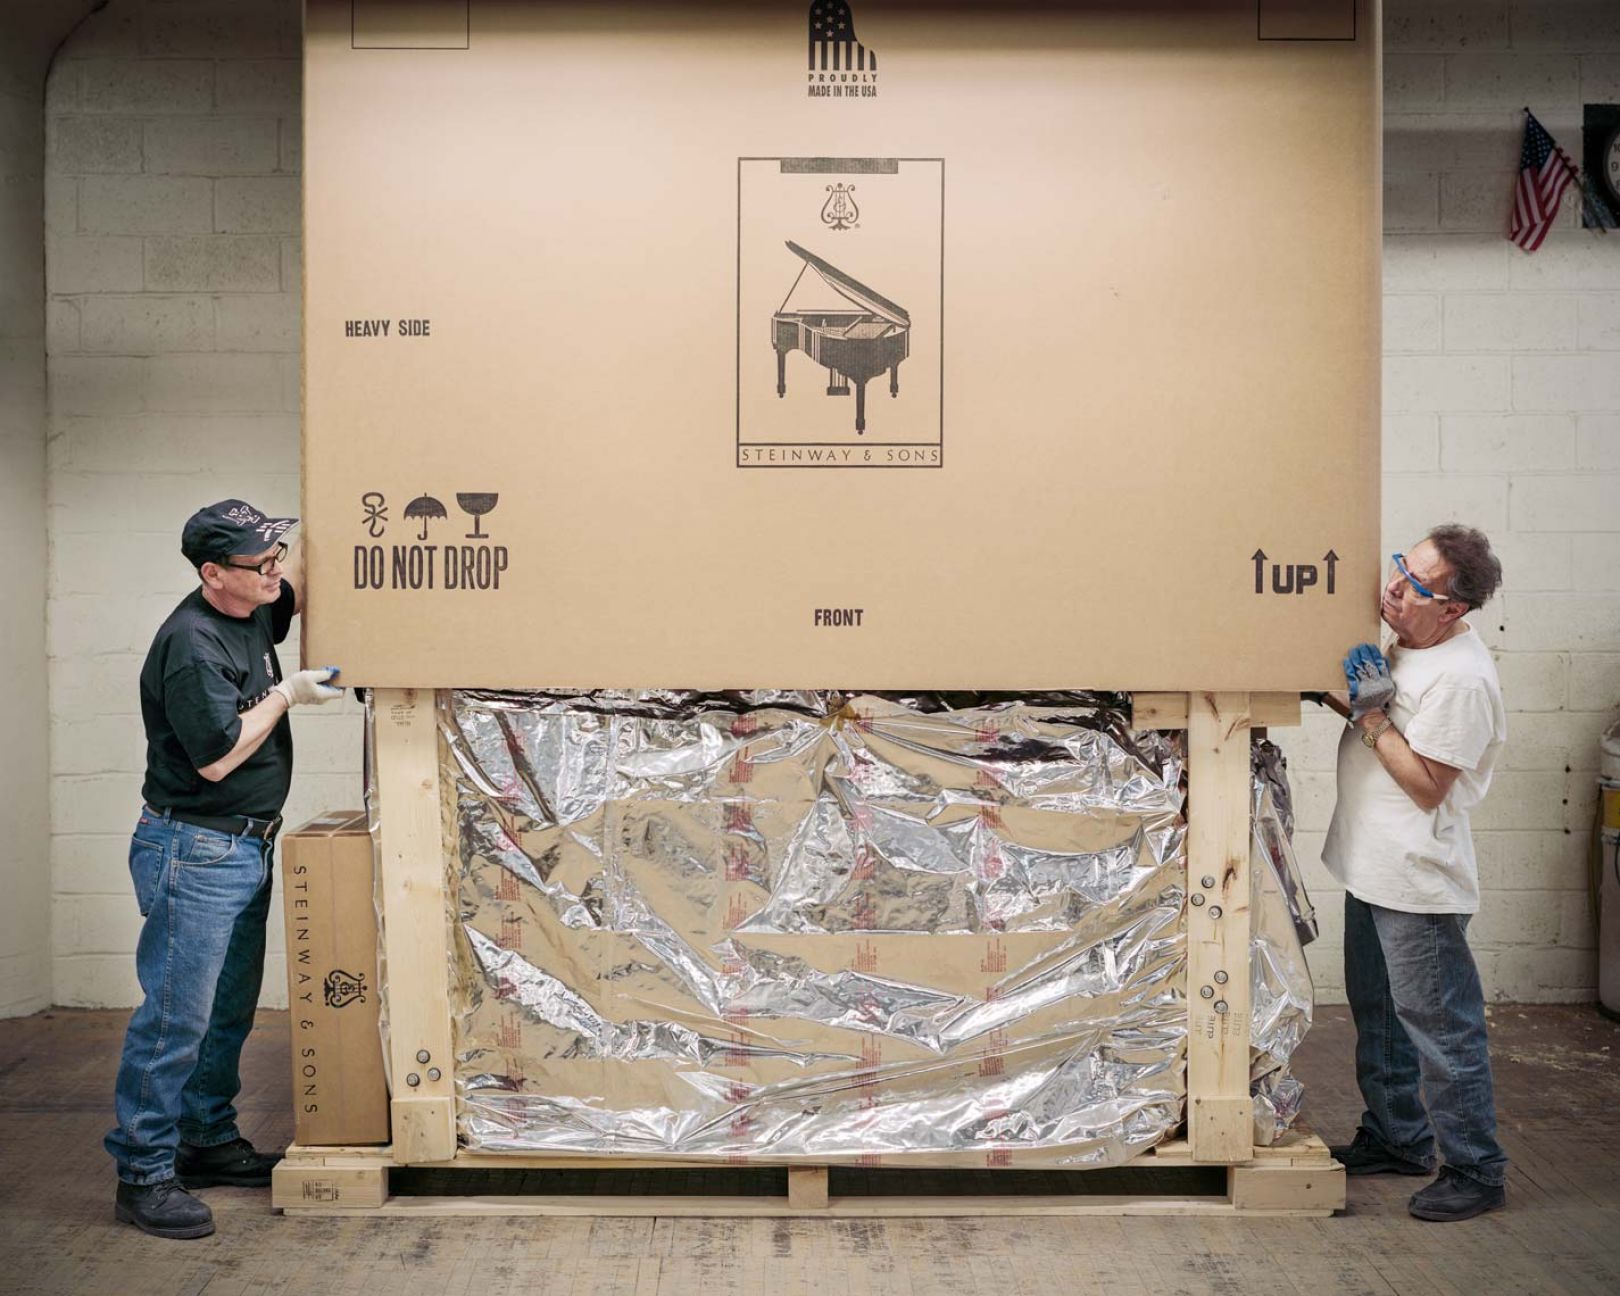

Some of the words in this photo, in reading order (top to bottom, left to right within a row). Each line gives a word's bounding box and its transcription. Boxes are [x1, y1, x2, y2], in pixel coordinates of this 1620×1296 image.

[808, 74, 877, 83] PROUDLY
[808, 85, 831, 97] MADE
[833, 85, 842, 97] IN
[845, 85, 859, 97] THE
[861, 85, 877, 97] USA
[345, 320, 390, 337] HEAVY
[399, 319, 430, 336] SIDE
[742, 449, 851, 461] STEINWAY
[863, 449, 872, 461] &
[887, 449, 938, 462] SONS
[354, 545, 385, 590] DO
[392, 545, 438, 590] NOT
[444, 545, 508, 590] DROP
[1272, 564, 1318, 594] UP
[814, 608, 864, 627] FRONT
[293, 865, 312, 1003] STEINWAY
[300, 1019, 314, 1030] &
[301, 1048, 318, 1114] SONS
